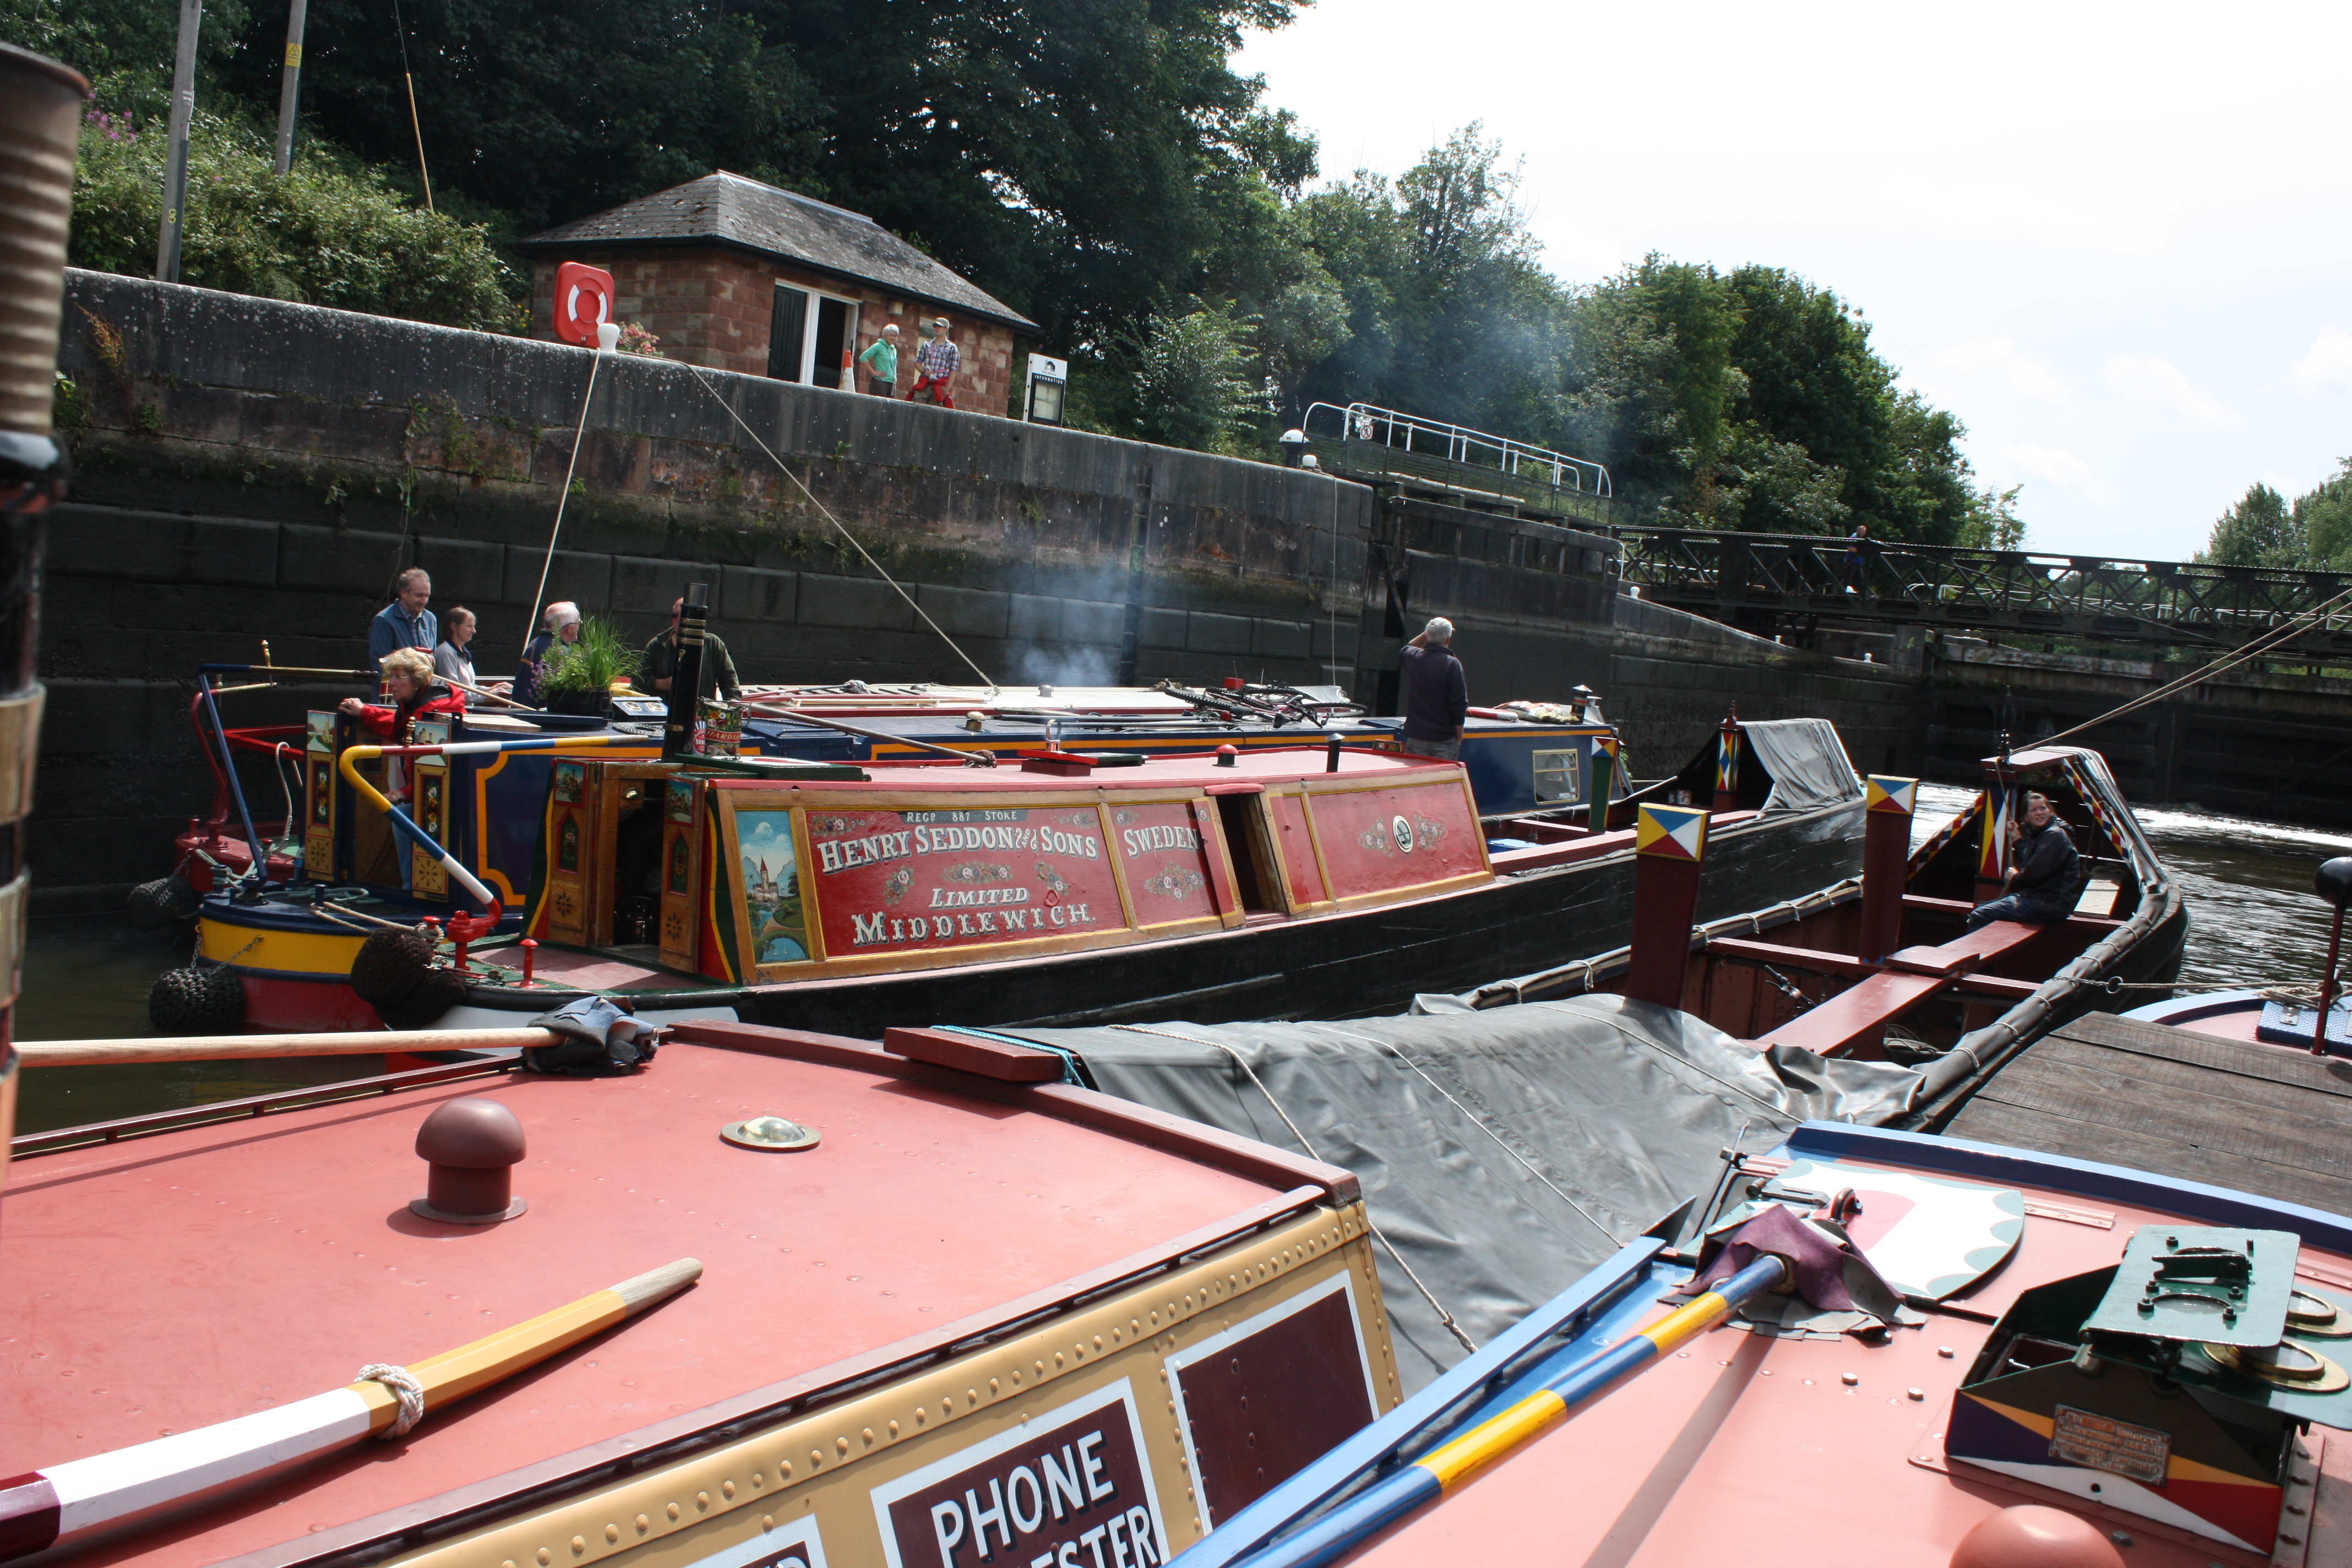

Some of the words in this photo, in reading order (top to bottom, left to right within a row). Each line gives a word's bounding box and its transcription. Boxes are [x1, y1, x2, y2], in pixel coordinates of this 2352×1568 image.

[1034, 374, 1063, 384] INFORMATION
[952, 812, 970, 822] 887
[985, 810, 1017, 821] STOKE
[817, 830, 911, 875] HENRY
[914, 825, 1016, 855] SEDDON
[1040, 825, 1098, 860] SONS
[1124, 825, 1200, 859] SWEDEN
[928, 886, 1029, 910] LIMITED
[930, 1430, 1114, 1568] PHONE
